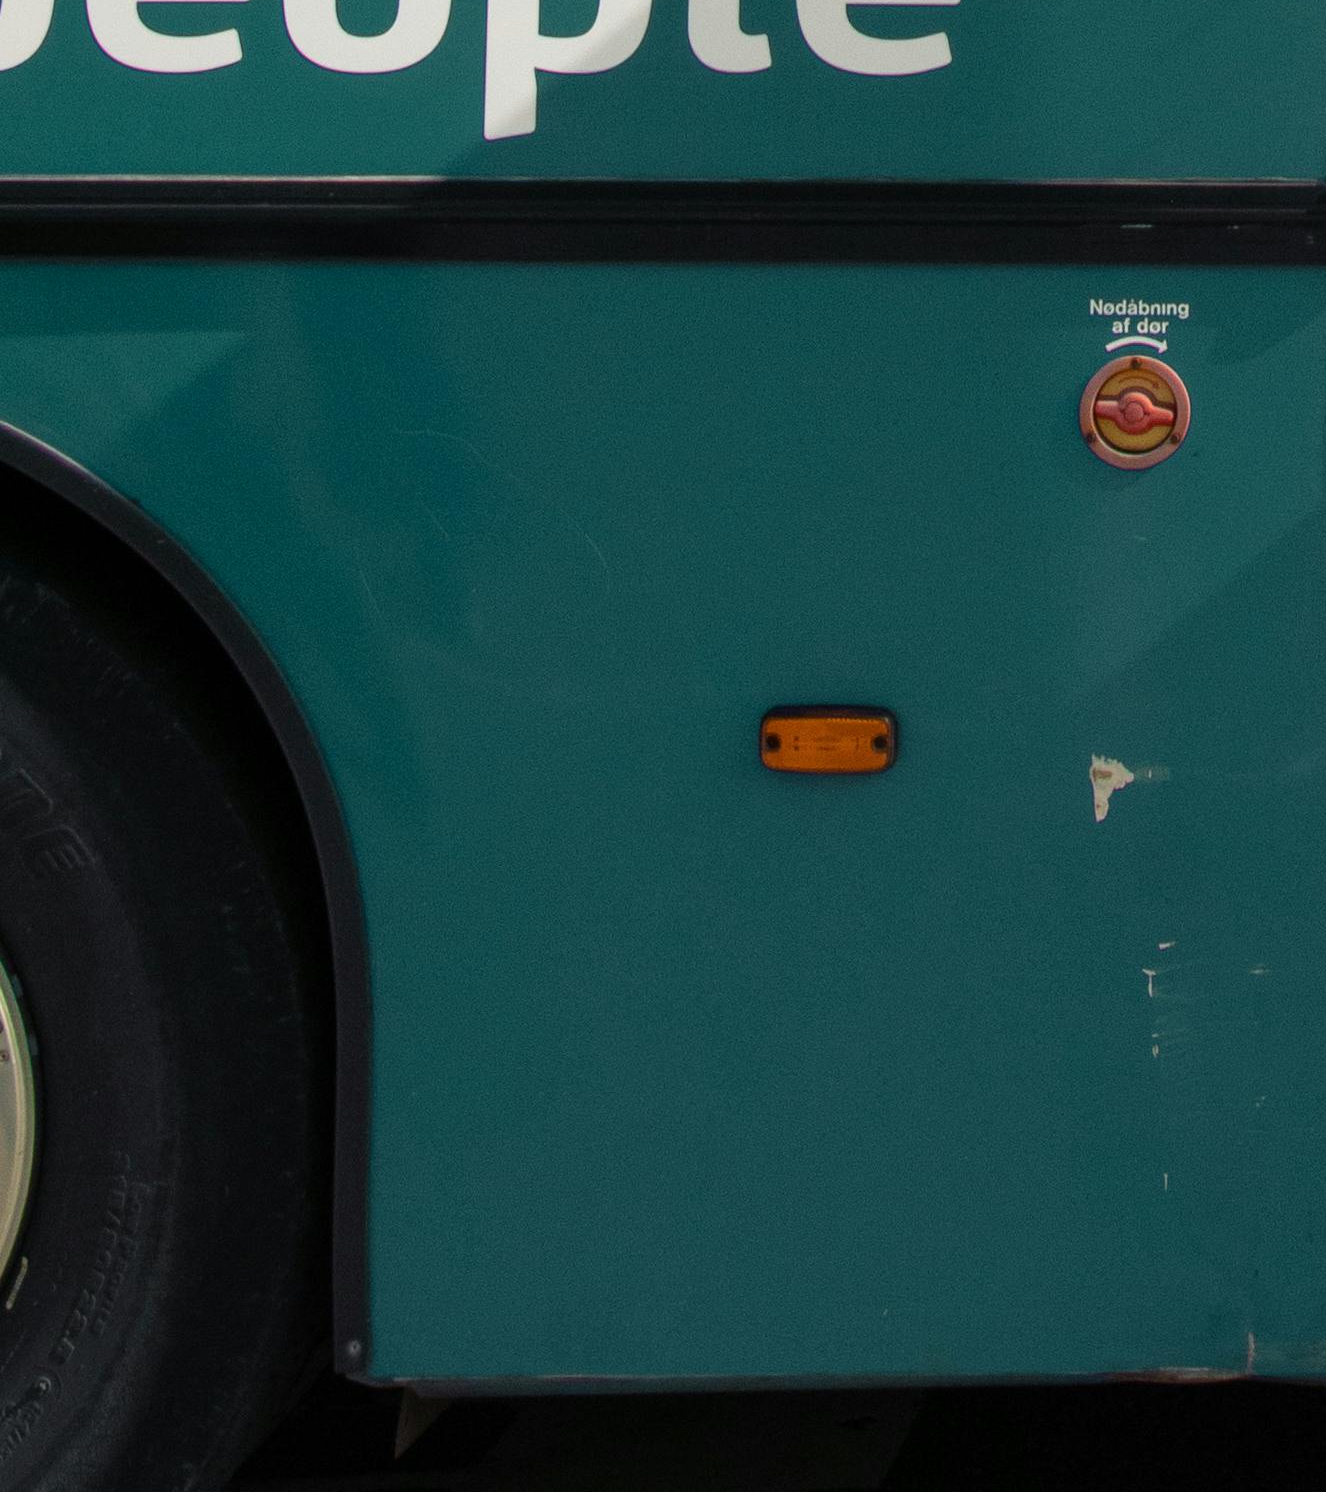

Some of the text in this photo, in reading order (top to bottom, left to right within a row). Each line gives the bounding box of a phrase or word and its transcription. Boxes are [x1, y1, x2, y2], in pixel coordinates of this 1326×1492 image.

[1089, 299, 1190, 320] Nødåbning
[1112, 318, 1170, 335] af dør
